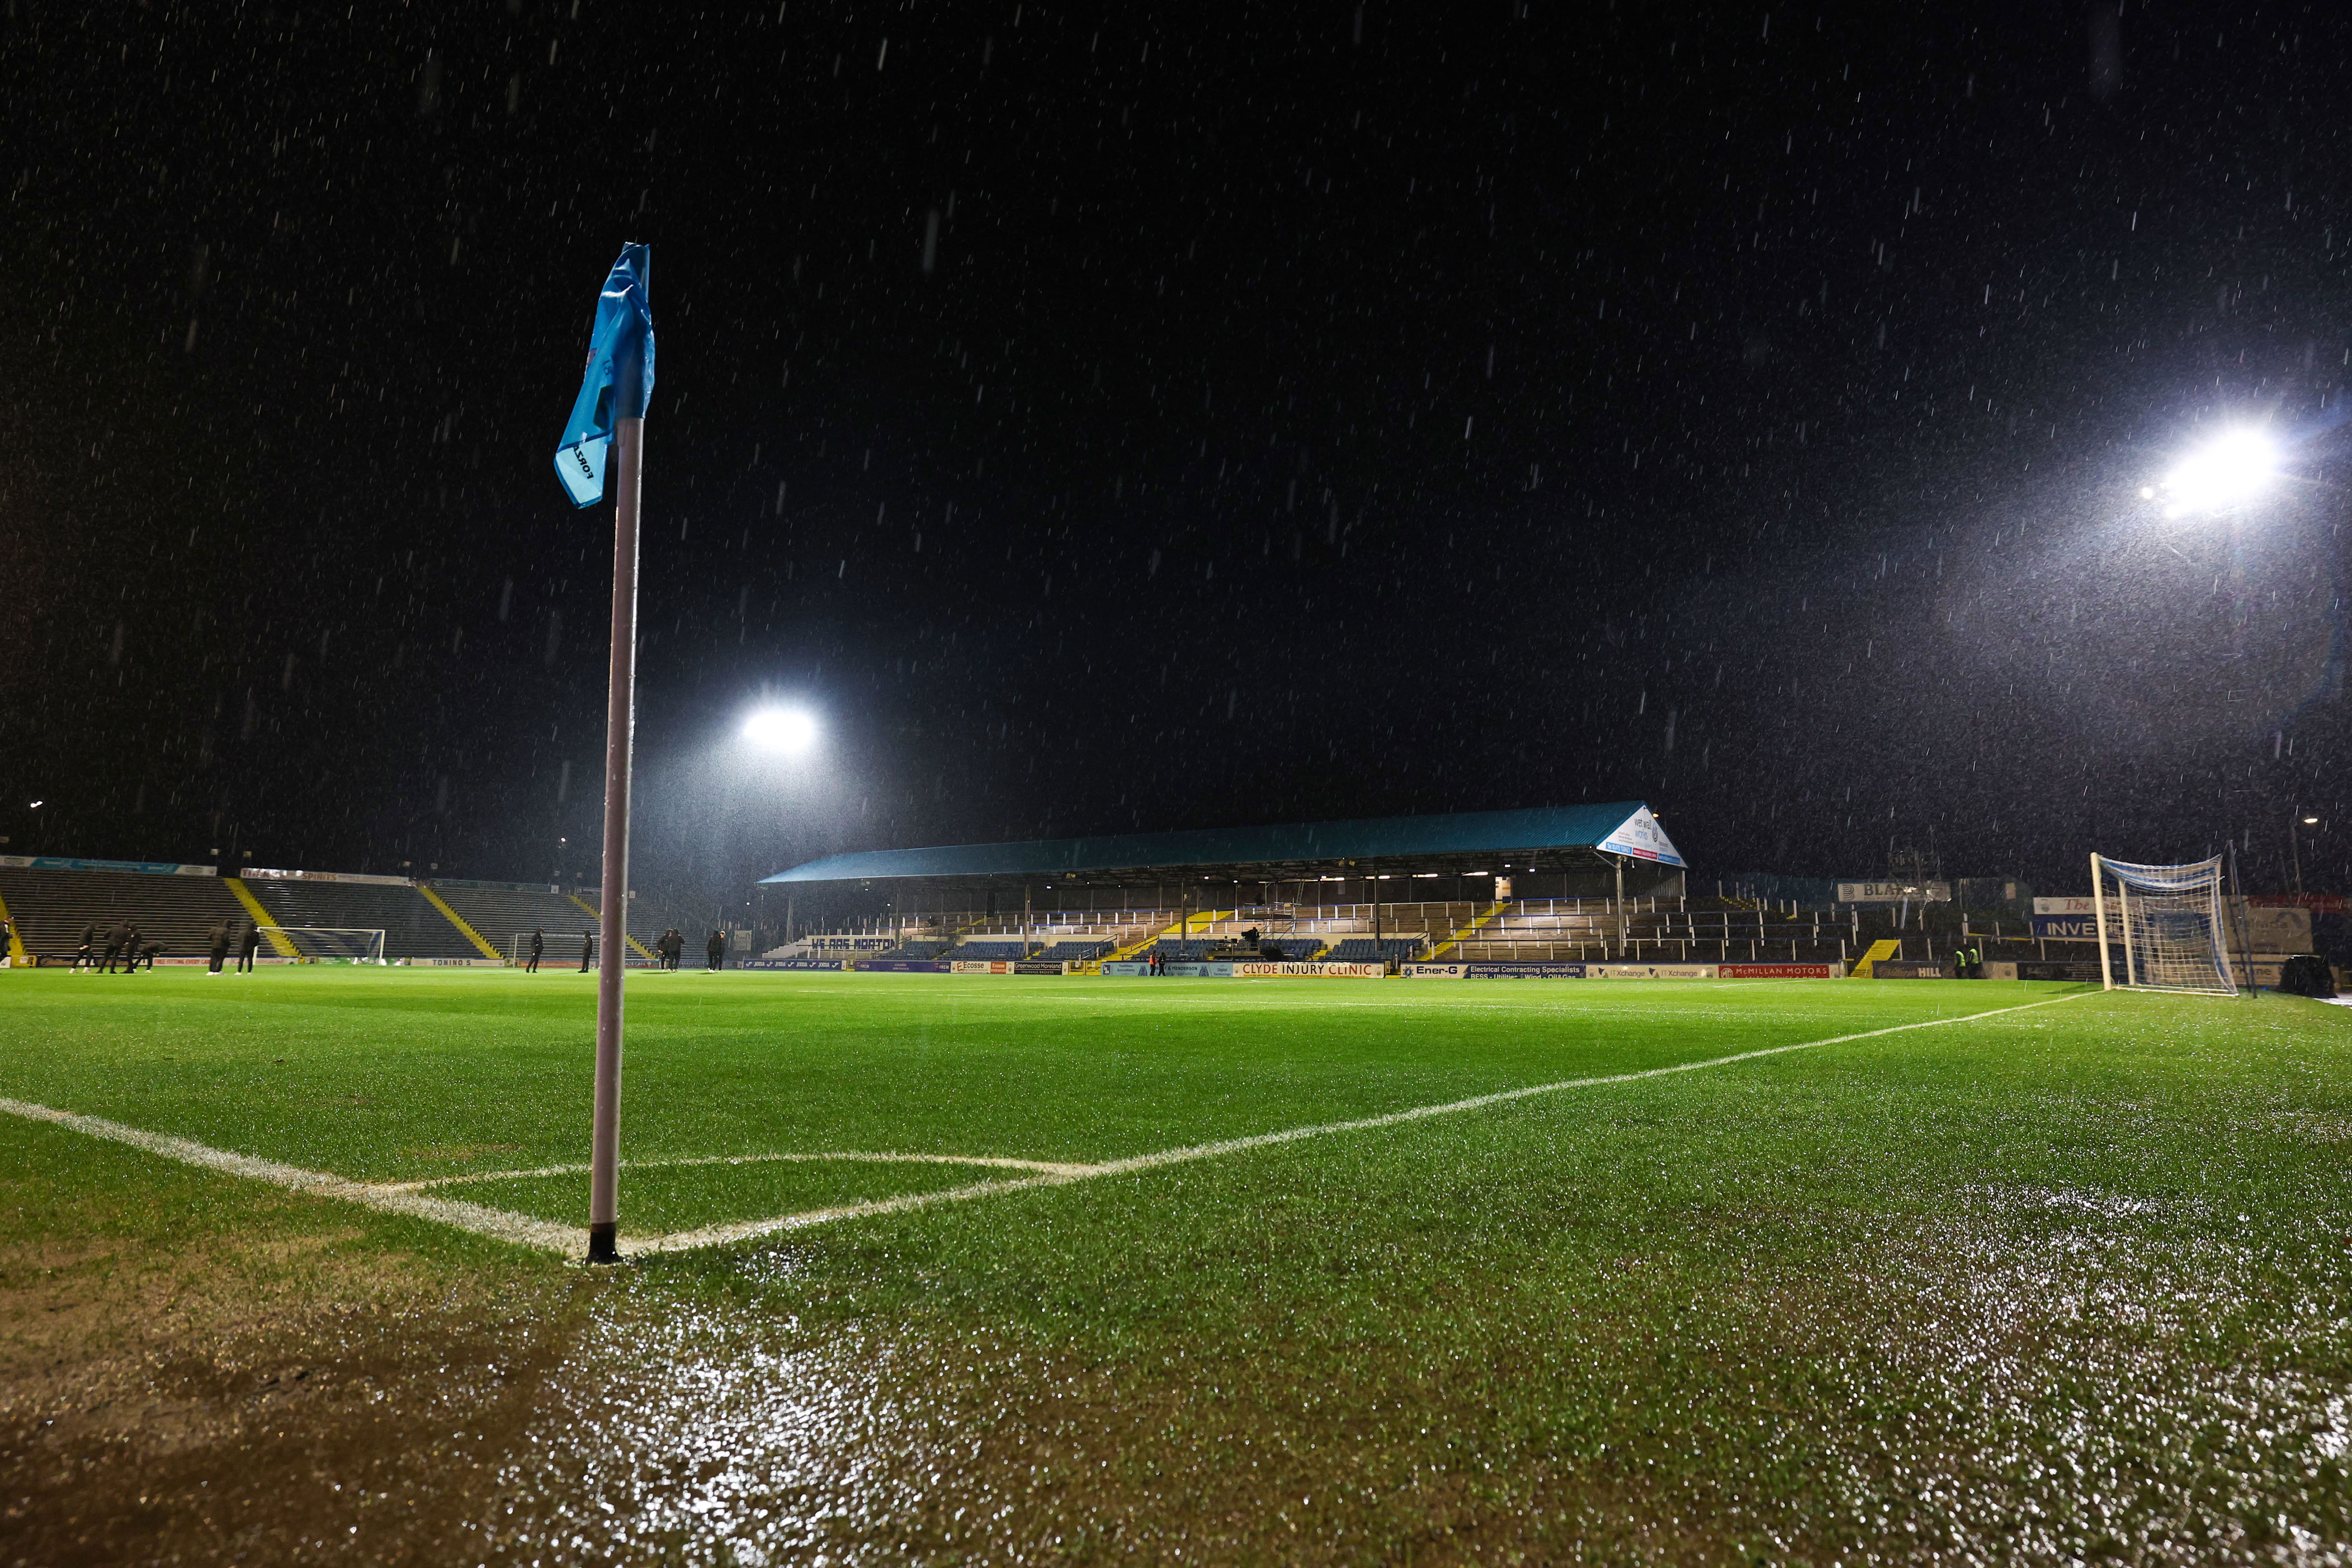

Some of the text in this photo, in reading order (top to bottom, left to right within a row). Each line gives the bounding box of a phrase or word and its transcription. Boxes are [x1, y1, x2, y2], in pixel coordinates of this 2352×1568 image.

[302, 872, 337, 881] SPIRITS
[2064, 899, 2090, 910] The
[1243, 964, 1372, 975] CLYDE INJURY CLINIC
[1416, 966, 1458, 974] Ener-G
[1918, 967, 1942, 977] HILL
